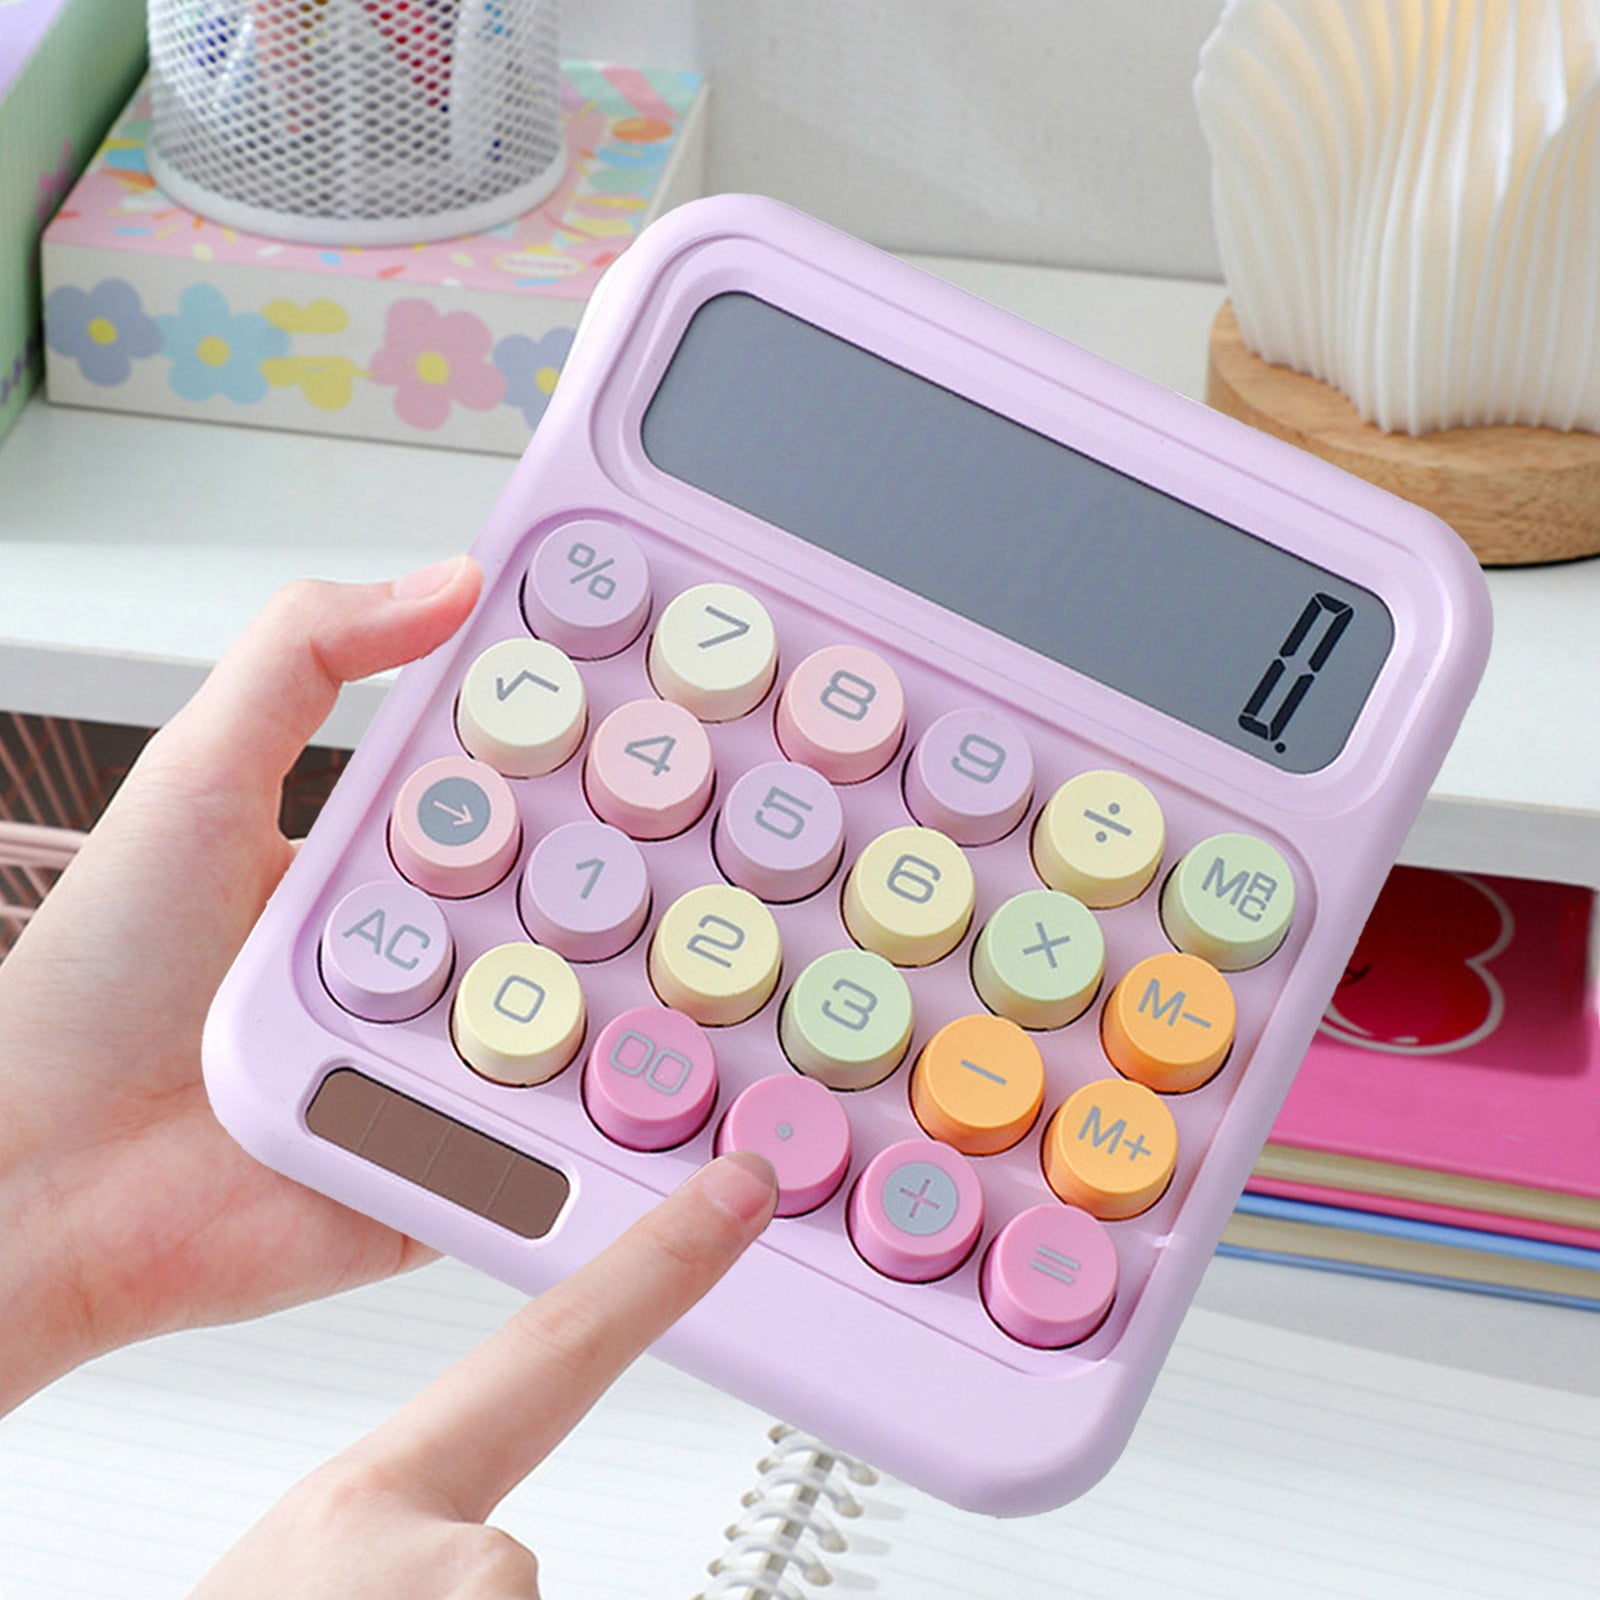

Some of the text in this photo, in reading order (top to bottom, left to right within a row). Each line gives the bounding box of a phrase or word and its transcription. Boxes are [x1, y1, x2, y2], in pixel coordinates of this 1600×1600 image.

[698, 605, 750, 649] 7
[820, 670, 877, 721] 8
[624, 735, 676, 776] 4
[951, 733, 1006, 784] 9
[754, 786, 813, 840] 5
[576, 857, 605, 900] 1
[886, 854, 942, 904] 6
[342, 908, 430, 970] AC
[687, 914, 745, 969] 2
[821, 978, 878, 1031] 3
[1078, 1106, 1151, 1162] M+
